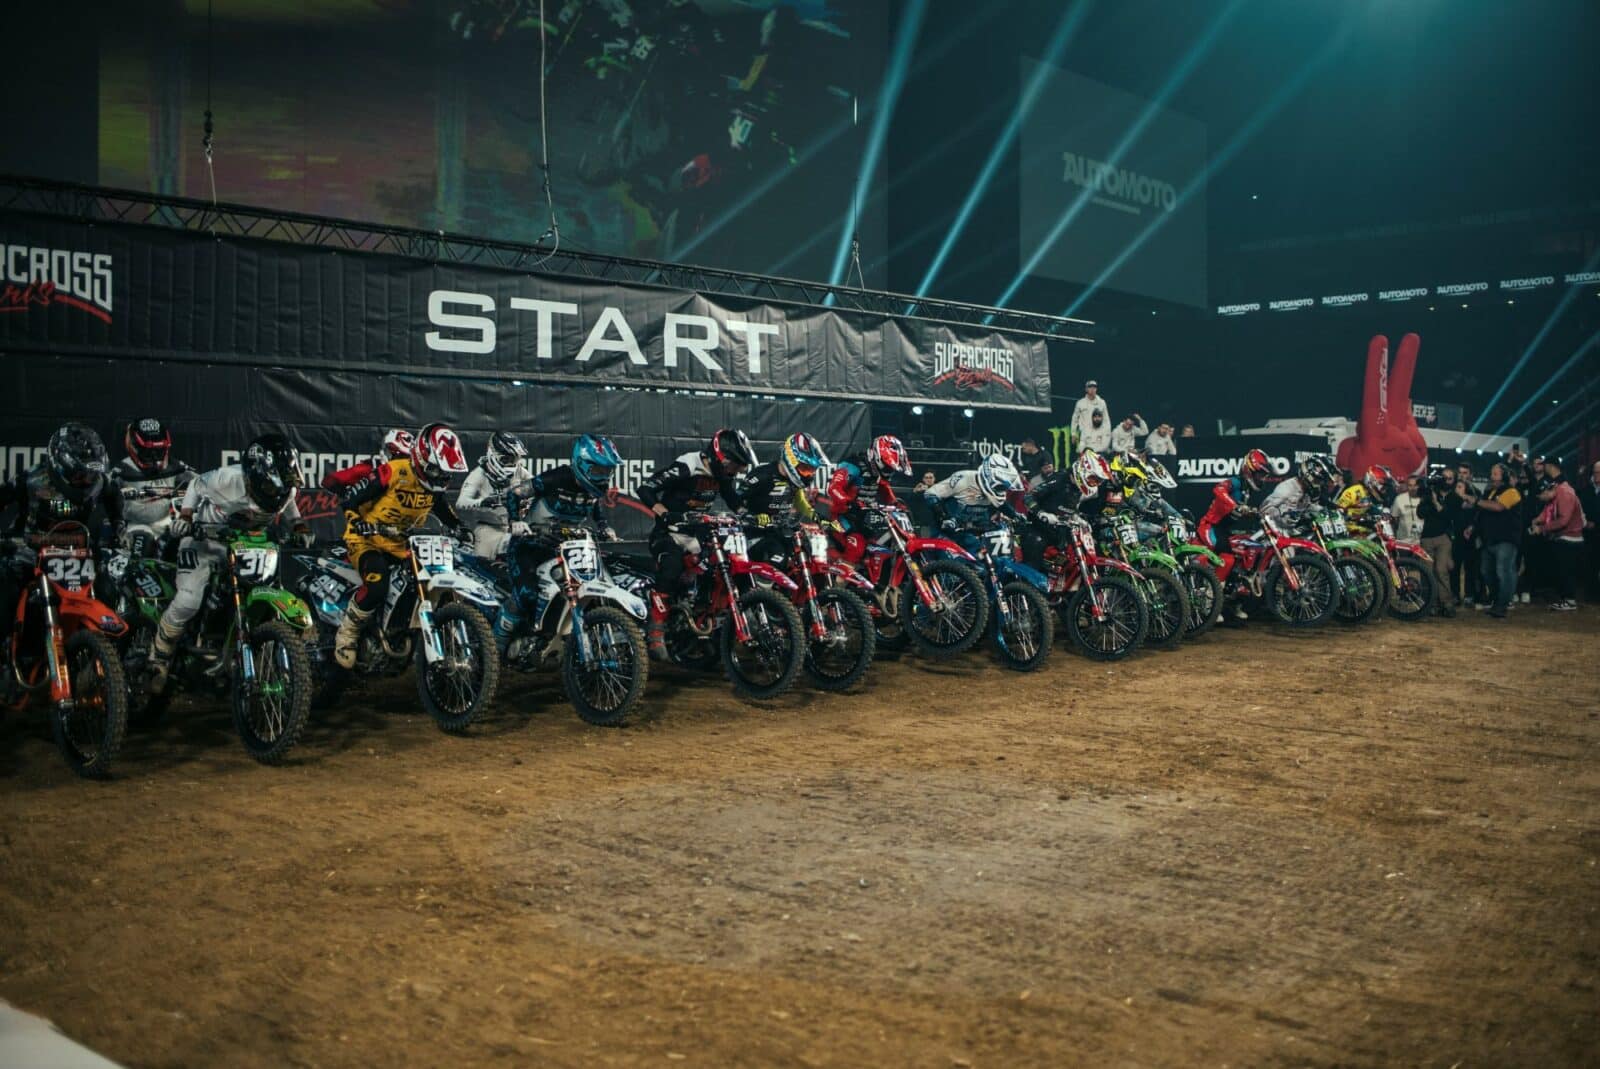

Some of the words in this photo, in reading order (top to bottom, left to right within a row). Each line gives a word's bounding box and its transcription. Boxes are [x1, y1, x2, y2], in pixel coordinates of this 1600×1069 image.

[1062, 151, 1177, 212] AUTOMOTO
[1437, 282, 1489, 294] AUTOMOTO
[1500, 276, 1555, 288] AUTOMOTO
[1321, 293, 1369, 305] AUTOMOTO
[1378, 287, 1428, 300] AUTOMOTO
[1217, 303, 1260, 314] AUTOMOTO
[1269, 298, 1314, 310] AUTOMOTO
[425, 289, 780, 374] START
[934, 341, 1014, 385] SUPERCROSS
[46, 557, 97, 582] 324
